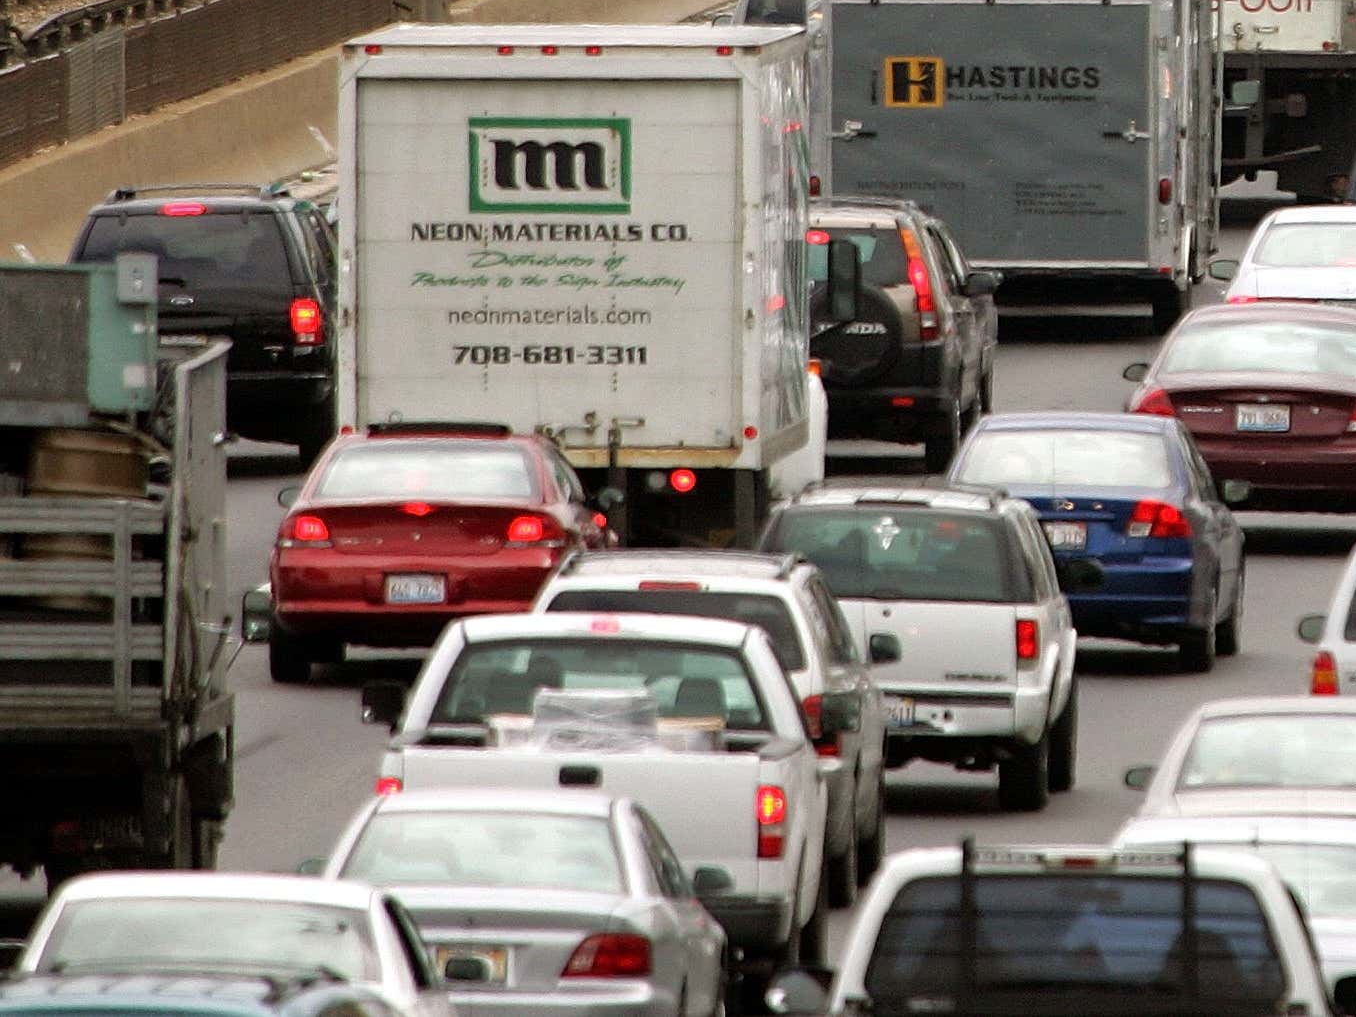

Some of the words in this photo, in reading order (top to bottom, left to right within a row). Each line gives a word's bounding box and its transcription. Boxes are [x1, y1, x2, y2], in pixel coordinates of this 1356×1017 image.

[947, 66, 1100, 89] HASTINGS
[410, 223, 482, 243] NEON
[492, 223, 643, 243] MATERIALS
[650, 223, 693, 243] CO.
[448, 305, 652, 325] neonmaterials.com
[452, 345, 648, 366] 708-681-3311
